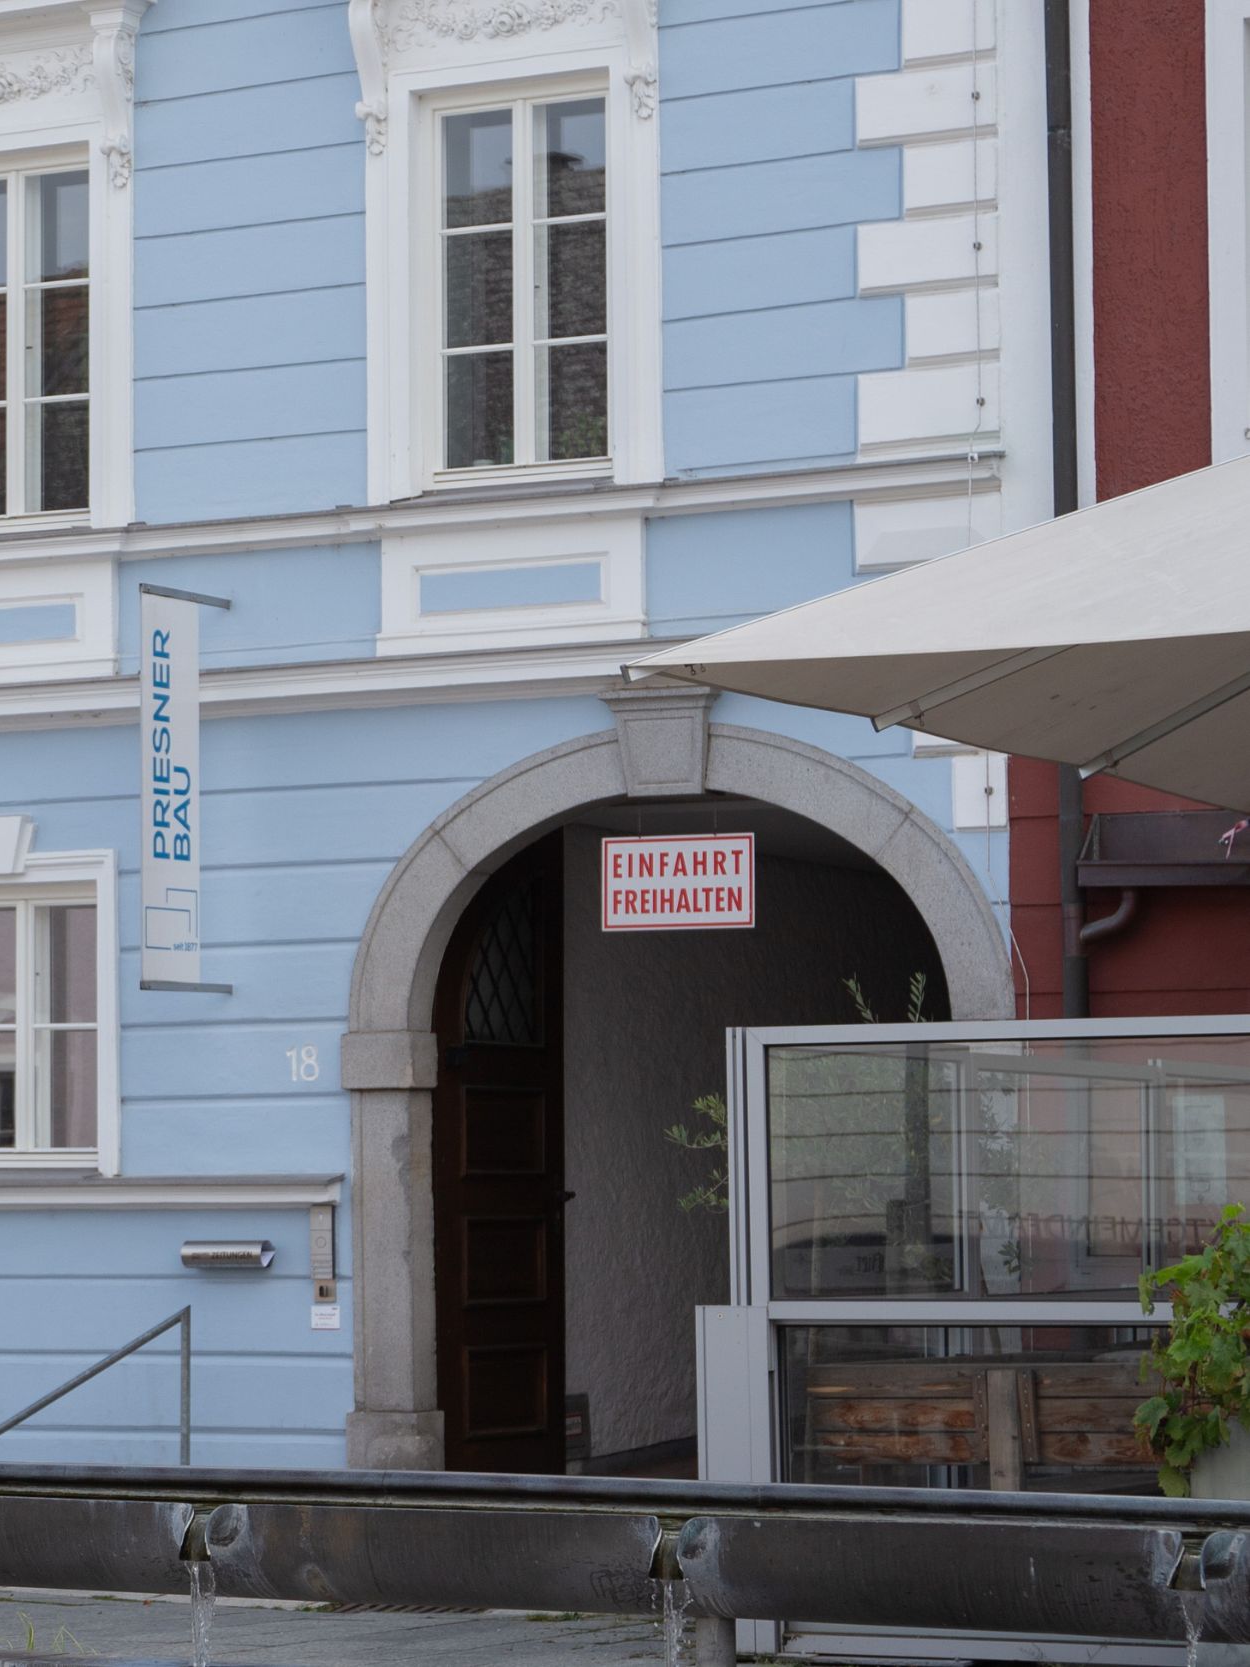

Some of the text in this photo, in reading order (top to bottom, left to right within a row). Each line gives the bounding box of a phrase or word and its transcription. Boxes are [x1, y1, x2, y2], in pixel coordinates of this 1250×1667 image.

[152, 628, 171, 860] PRIESNER
[173, 765, 191, 861] BAU
[612, 849, 744, 879] EINFAHRT
[612, 886, 743, 915] FREIHALTEN
[285, 1046, 319, 1081] 18
